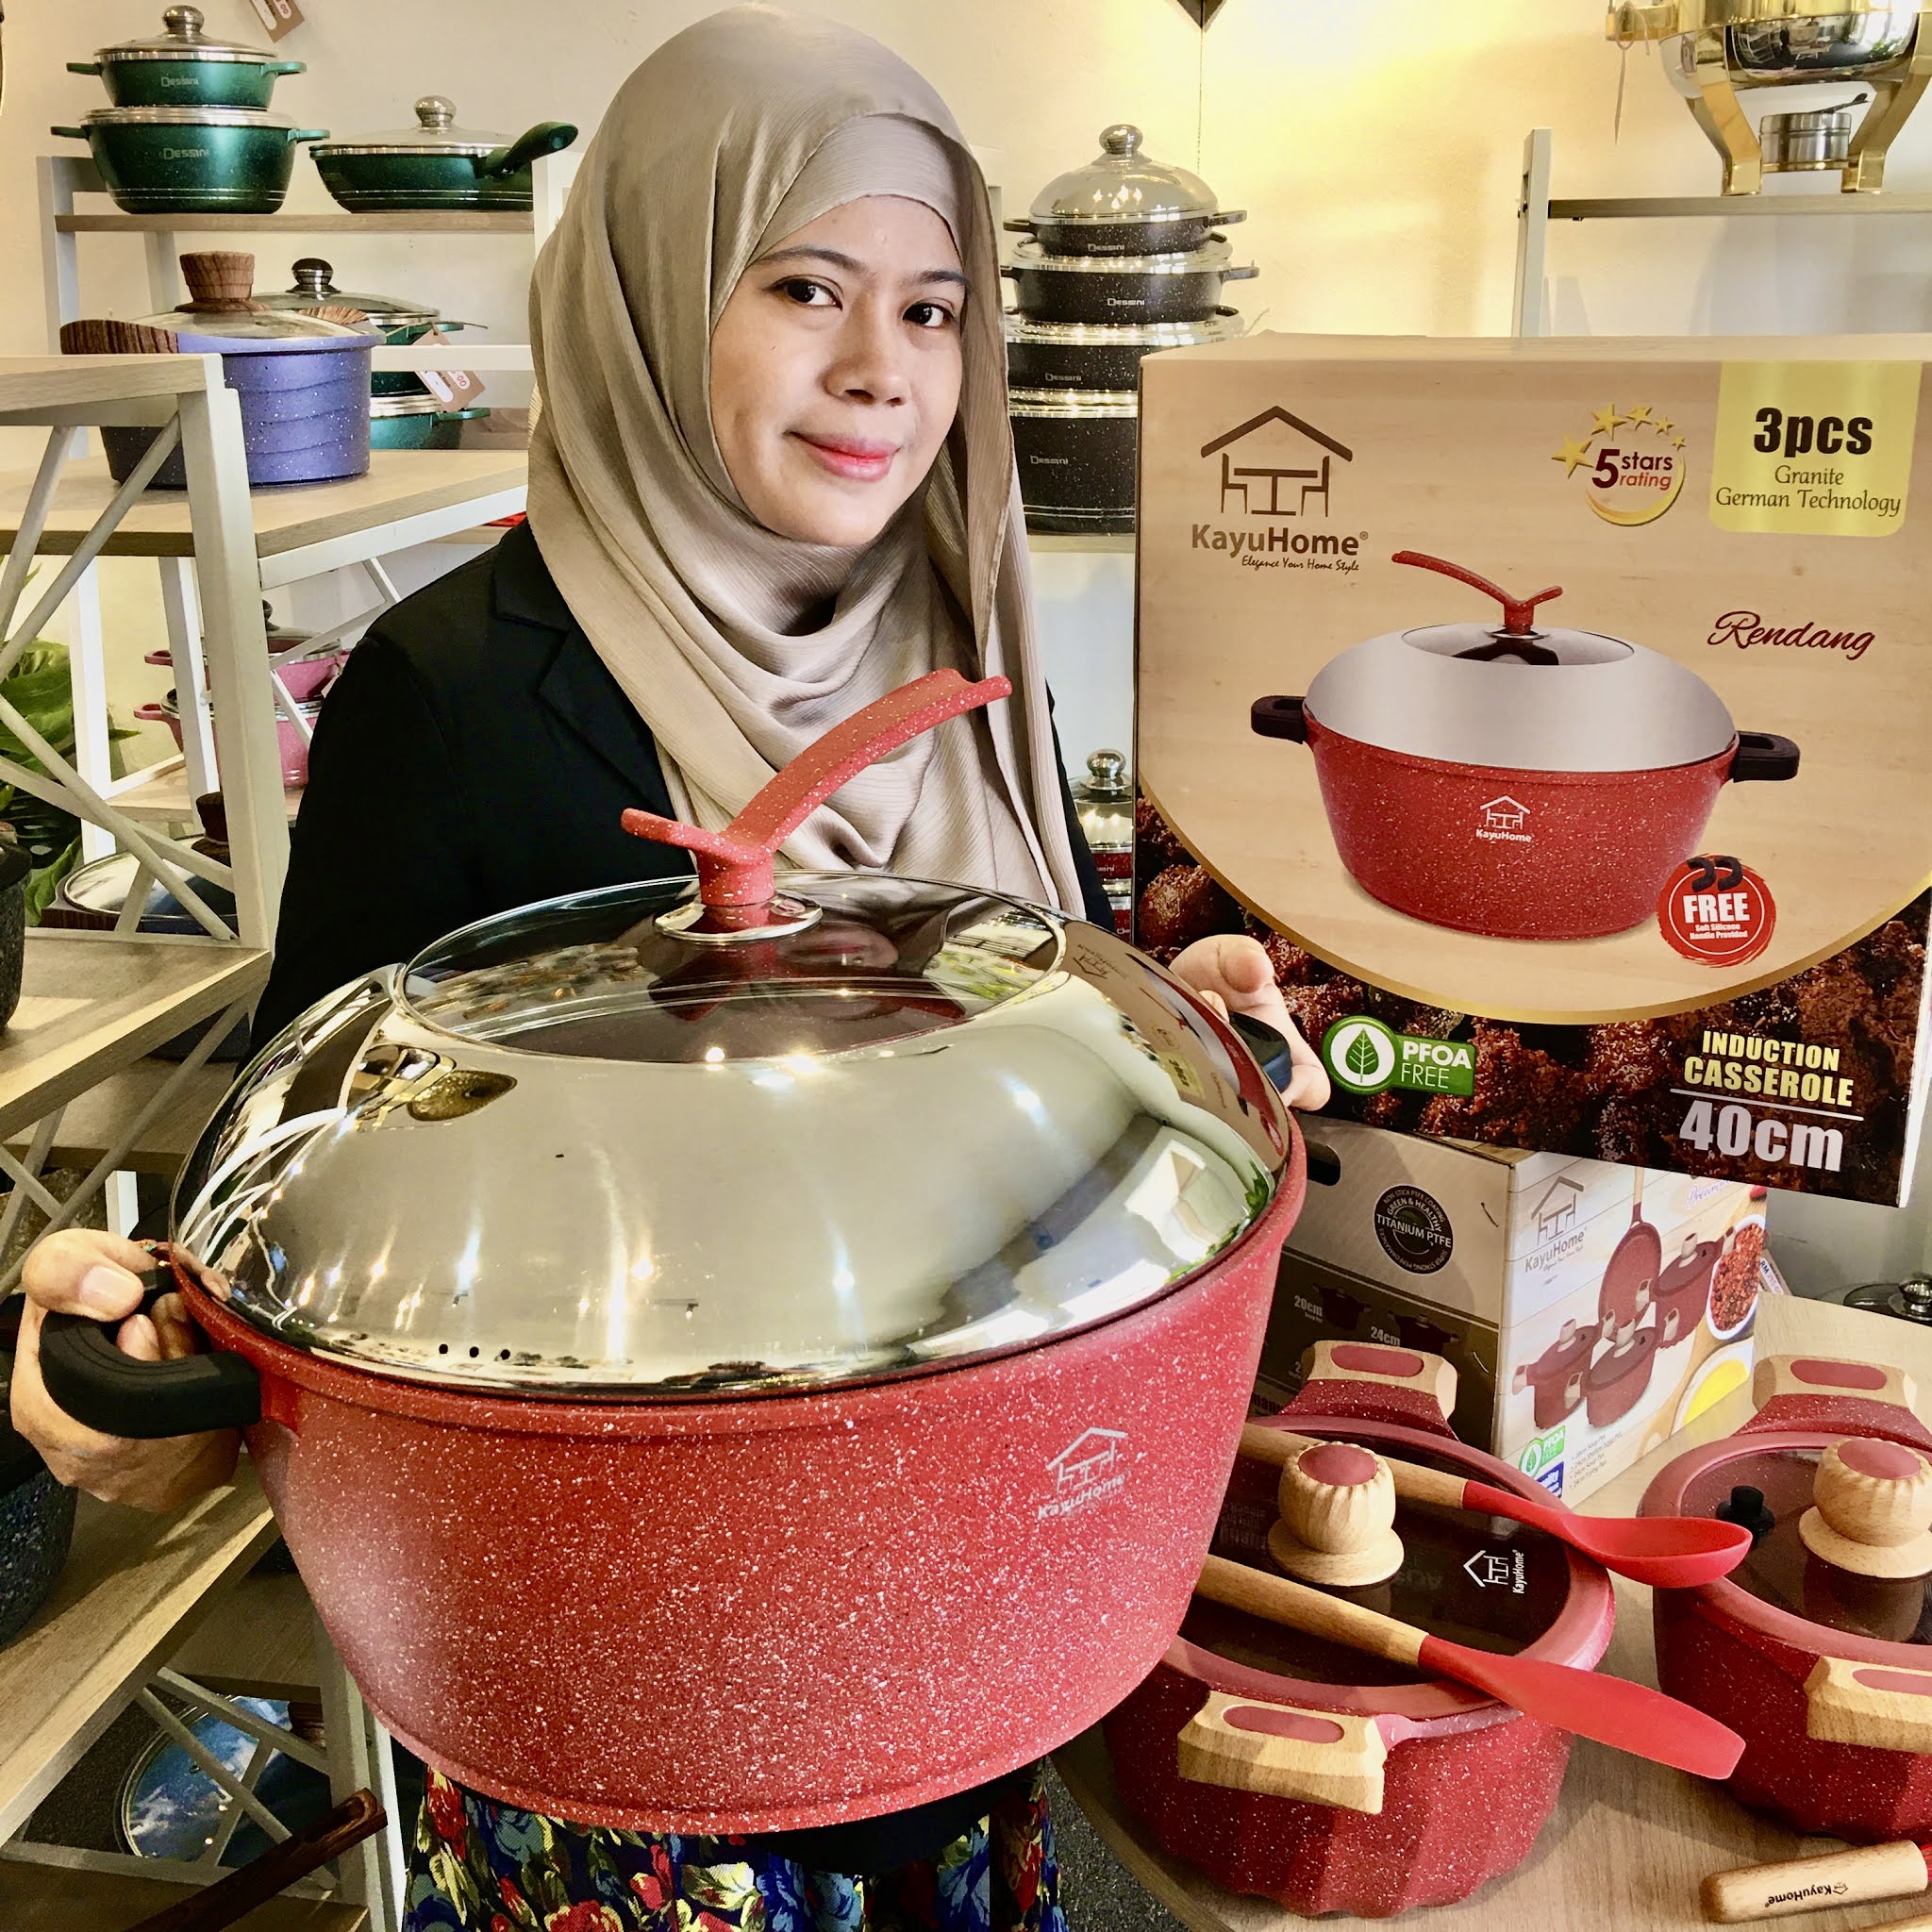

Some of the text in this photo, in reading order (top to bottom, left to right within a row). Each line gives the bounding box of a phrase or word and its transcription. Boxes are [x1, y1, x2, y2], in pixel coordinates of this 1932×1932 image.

[1753, 407, 1874, 458] 3pcs
[1591, 448, 1674, 489] 5 stars
[1620, 471, 1673, 491] rating
[1774, 465, 1845, 486] Granite
[1715, 487, 1902, 517] German Technology
[1241, 555, 1359, 575] Elegance Your Home Style
[1707, 610, 1876, 661] Rendang
[1475, 828, 1532, 843] KayuHome
[1682, 891, 1751, 924] FREE
[1402, 1040, 1473, 1070] PFOA
[1702, 1030, 1840, 1073] INDUCTION
[1401, 1062, 1450, 1090] FREE
[1684, 1056, 1855, 1108] CASSEROLE
[1679, 1099, 1843, 1173] 40cm
[1376, 1213, 1452, 1248] TITANIUM PTFE
[1387, 1197, 1442, 1232] GREEN & HEALTHY
[1524, 1231, 1585, 1274] KayuHome
[1293, 1294, 1323, 1317] 20cm
[1371, 1325, 1401, 1347] 24cm
[1038, 1474, 1125, 1520] KayuHome
[1768, 1883, 1832, 1905] KayuHome
